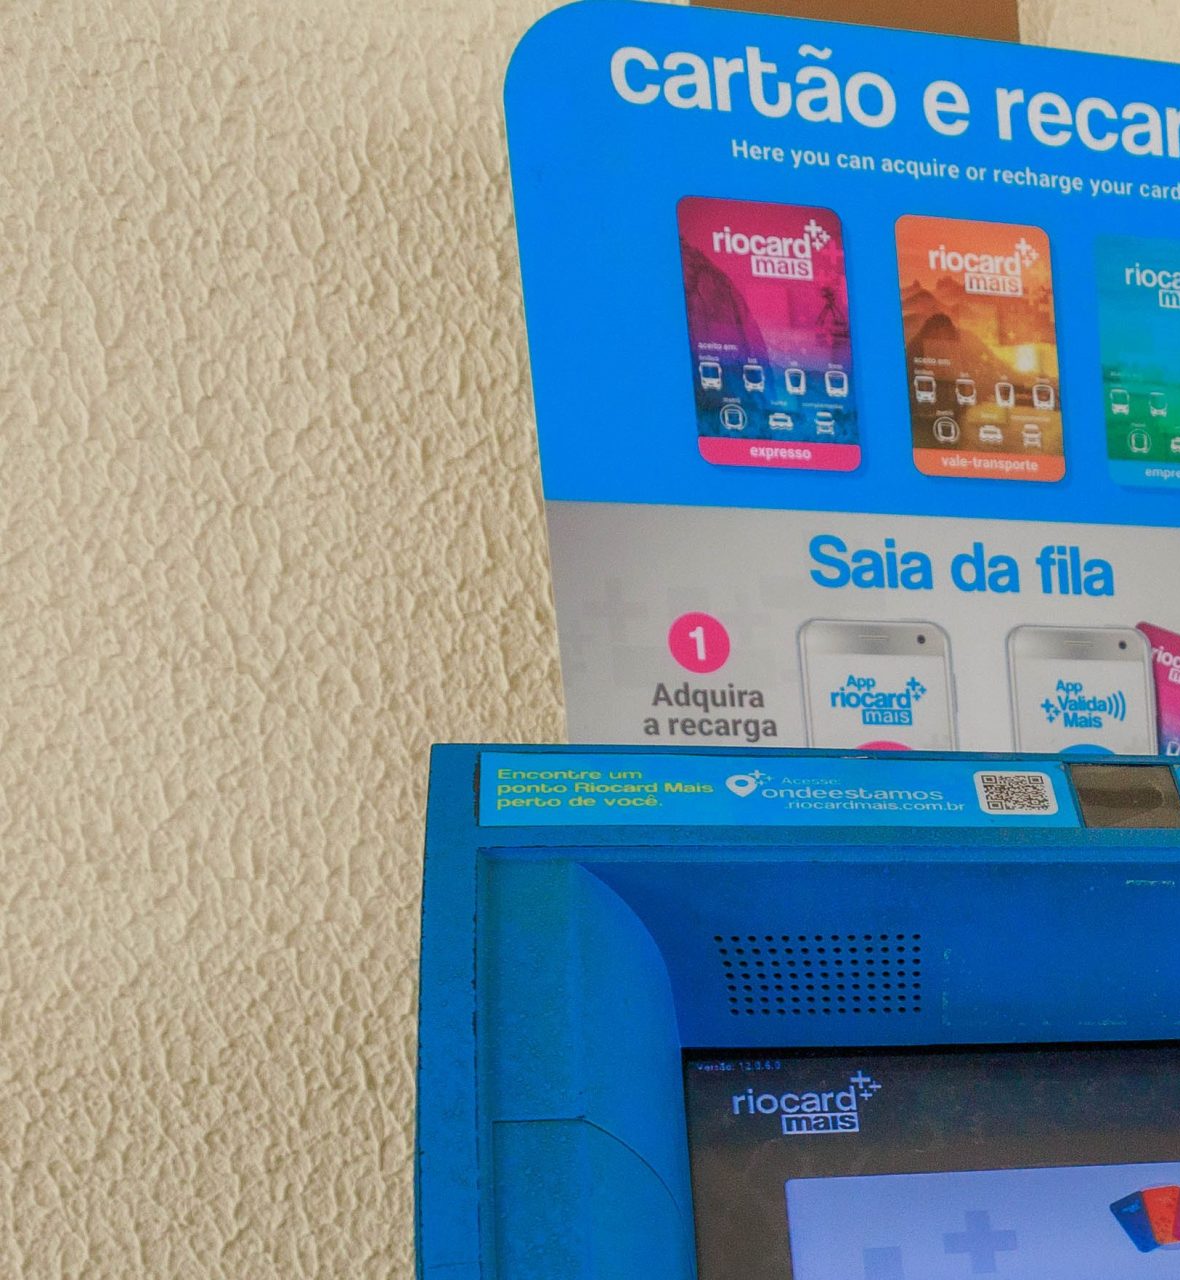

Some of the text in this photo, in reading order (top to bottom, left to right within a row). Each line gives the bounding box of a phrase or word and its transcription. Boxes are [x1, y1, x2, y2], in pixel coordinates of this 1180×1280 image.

[610, 44, 897, 128] cartão
[923, 79, 971, 136] e
[731, 139, 785, 162] Here
[791, 147, 830, 169] you
[837, 150, 875, 171] can
[881, 156, 960, 180] acquire
[965, 165, 986, 182] or
[993, 166, 1084, 195] recharge
[1089, 178, 1133, 197] your
[712, 226, 812, 259] riocard
[755, 258, 811, 278] mais
[928, 244, 1021, 276] riocard
[967, 274, 1020, 293] mais
[750, 445, 813, 462] expresso
[941, 454, 1039, 474] vale-transporte
[808, 533, 1115, 597] Saia da fila
[688, 626, 707, 661] 1
[846, 674, 876, 692] App
[1055, 679, 1083, 696] App
[651, 682, 765, 713] Adquira
[830, 686, 912, 709] riocard
[1058, 694, 1107, 713] Valida
[864, 709, 912, 725] mais
[1063, 711, 1103, 729] Mais
[643, 716, 778, 743] a recarga
[497, 769, 643, 780] Encontre um
[496, 782, 714, 797] ponto Riocard Mais
[761, 786, 944, 801] ondeestamos
[496, 795, 663, 810] perto de você.
[731, 1087, 858, 1115] riocard
[785, 1112, 857, 1132] mais
